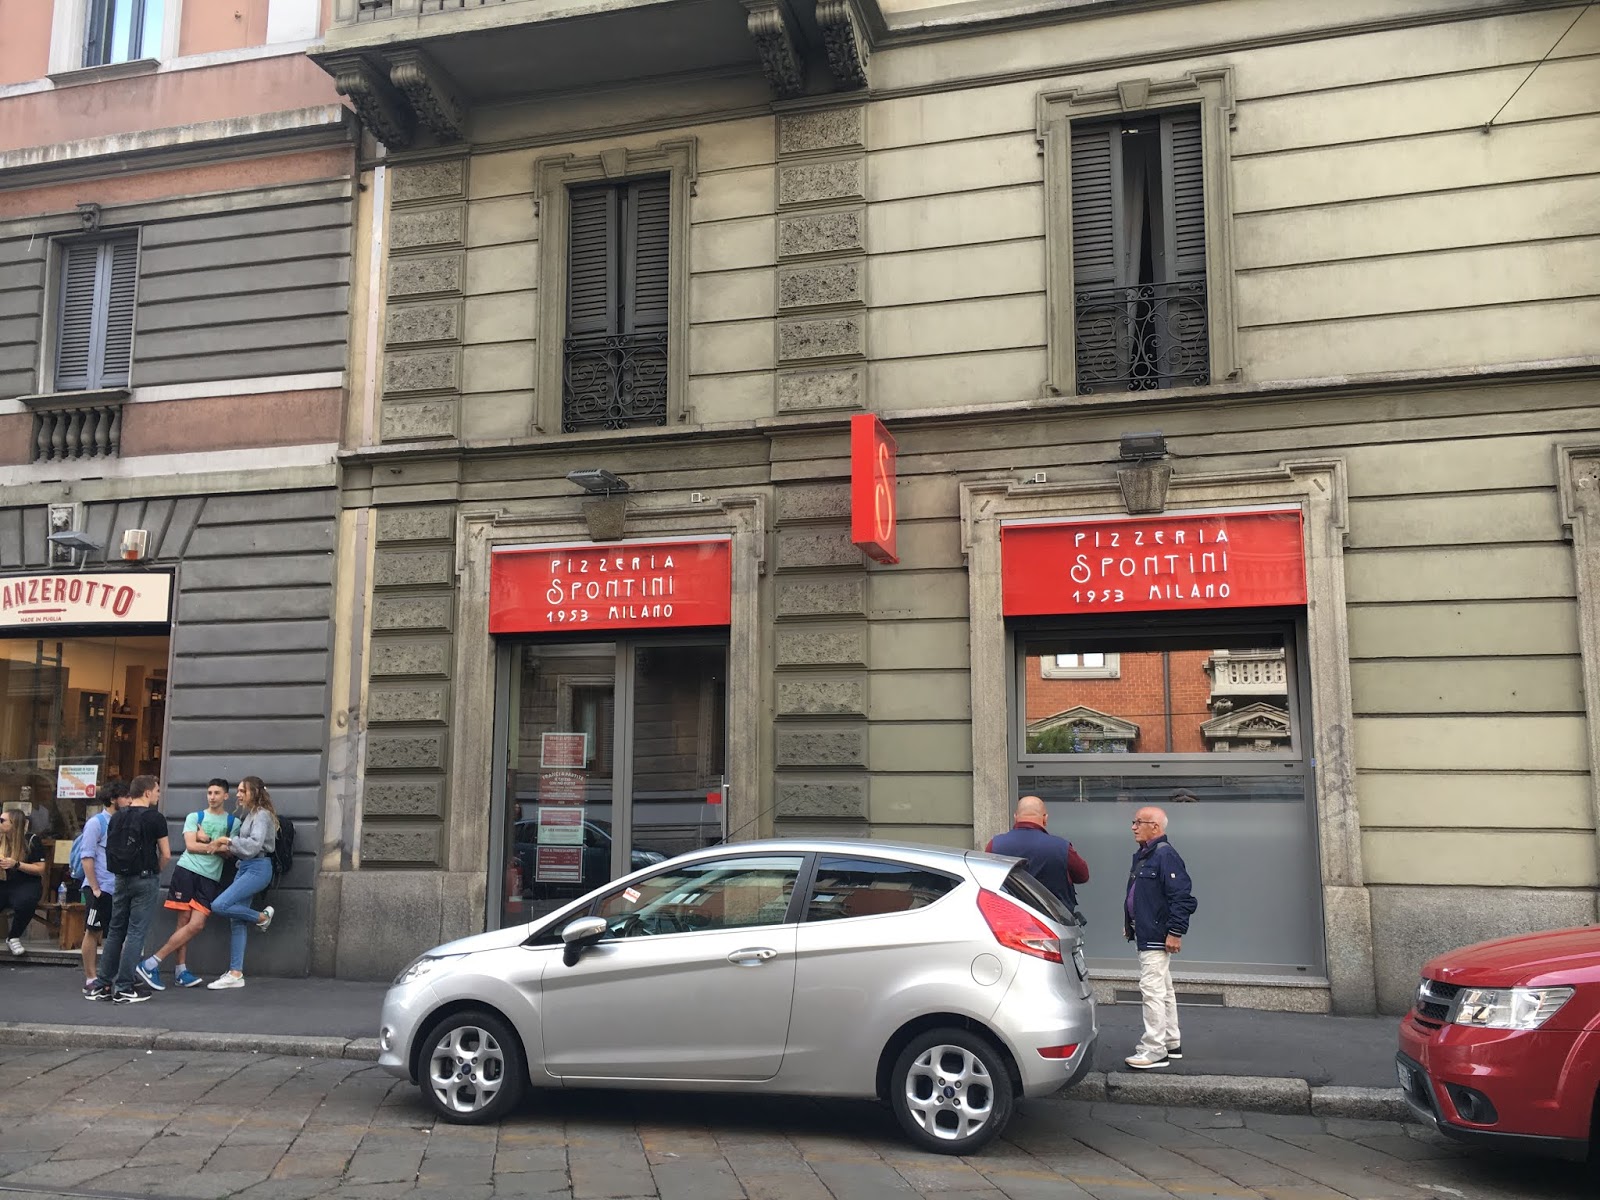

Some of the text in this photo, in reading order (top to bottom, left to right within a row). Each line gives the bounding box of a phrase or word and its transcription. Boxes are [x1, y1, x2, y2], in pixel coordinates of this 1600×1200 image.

[1074, 529, 1229, 548] PIZZERIA
[551, 555, 674, 574] PIZZERIA
[1070, 550, 1228, 584] SPONTINI
[546, 575, 674, 605] SPONTINI
[1072, 583, 1230, 603] 1953 MILANO
[546, 604, 673, 623] 1953 MILANO
